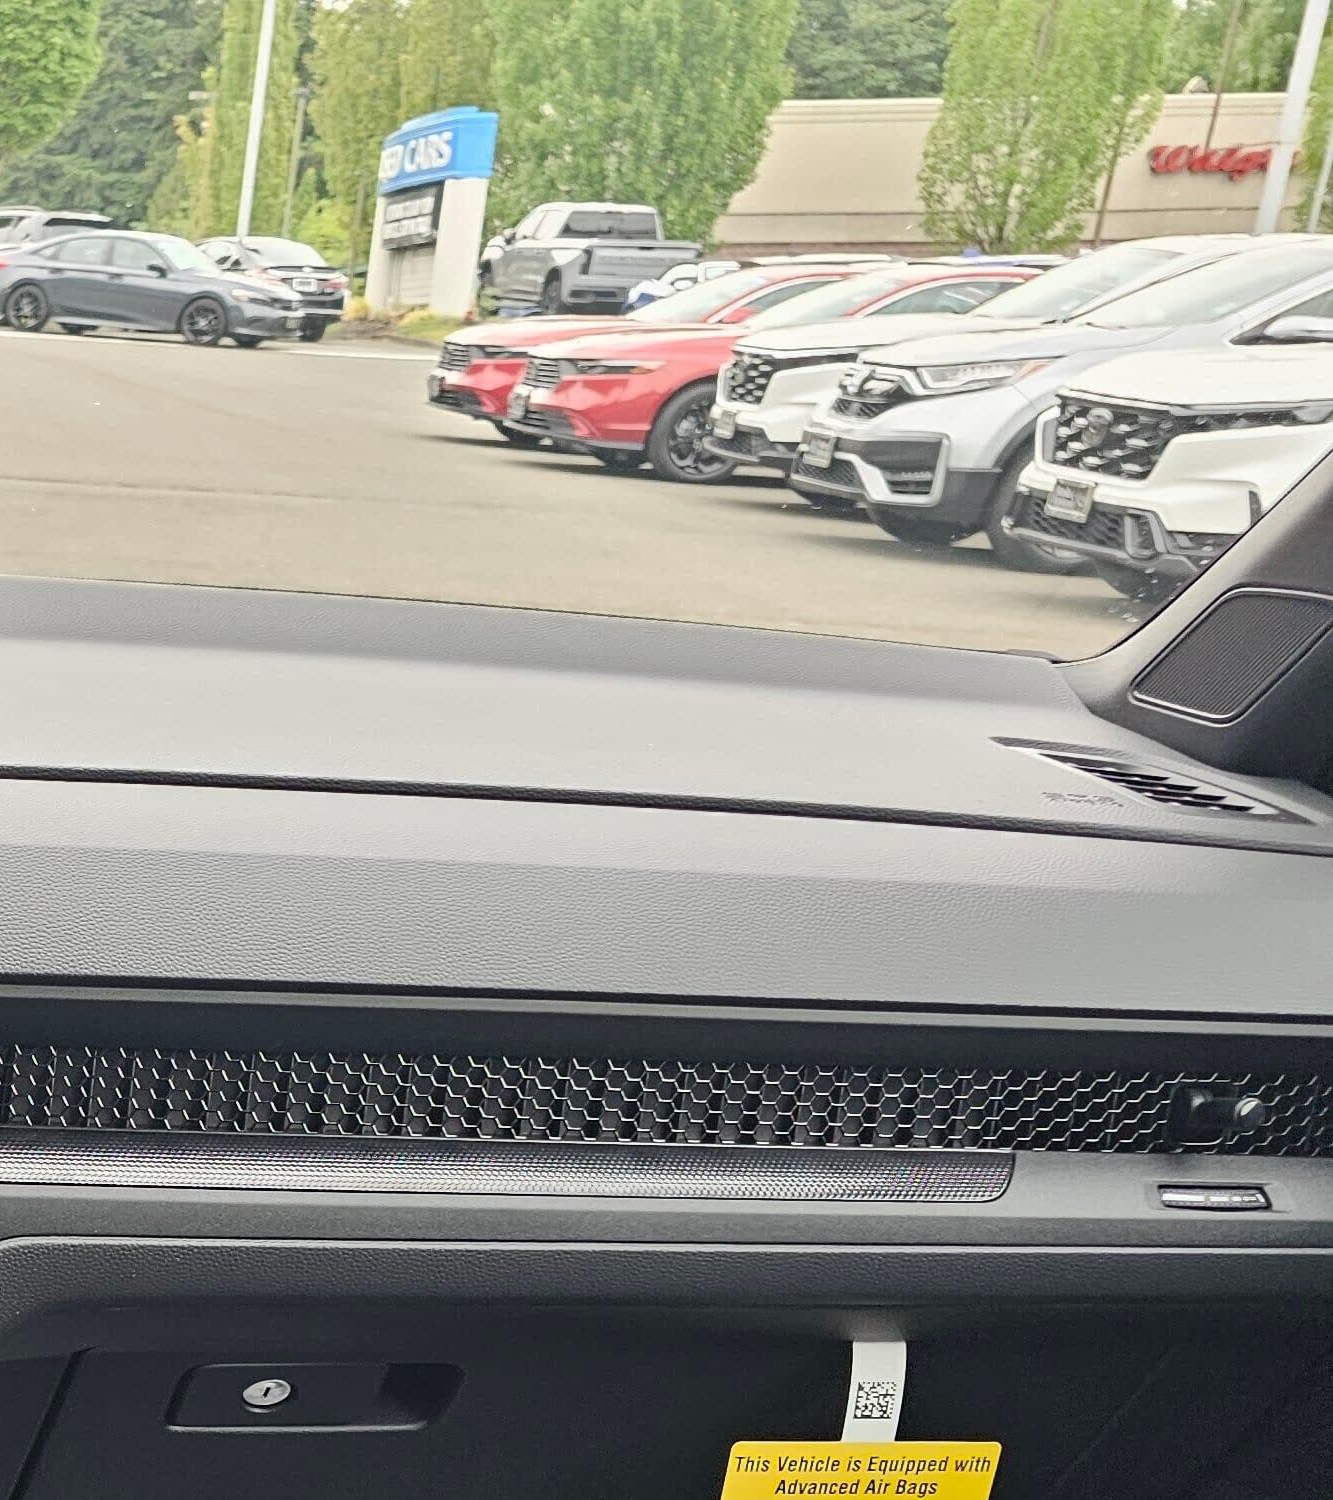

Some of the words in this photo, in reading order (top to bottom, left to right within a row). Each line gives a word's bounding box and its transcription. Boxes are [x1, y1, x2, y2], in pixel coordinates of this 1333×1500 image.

[735, 1456, 770, 1472] This
[778, 1456, 840, 1472] Vehicle
[847, 1456, 862, 1472] is
[867, 1456, 949, 1475] Equipped
[954, 1456, 991, 1472] with
[774, 1479, 861, 1495] Advanced
[864, 1479, 890, 1494] Air
[895, 1479, 938, 1498] Bags
